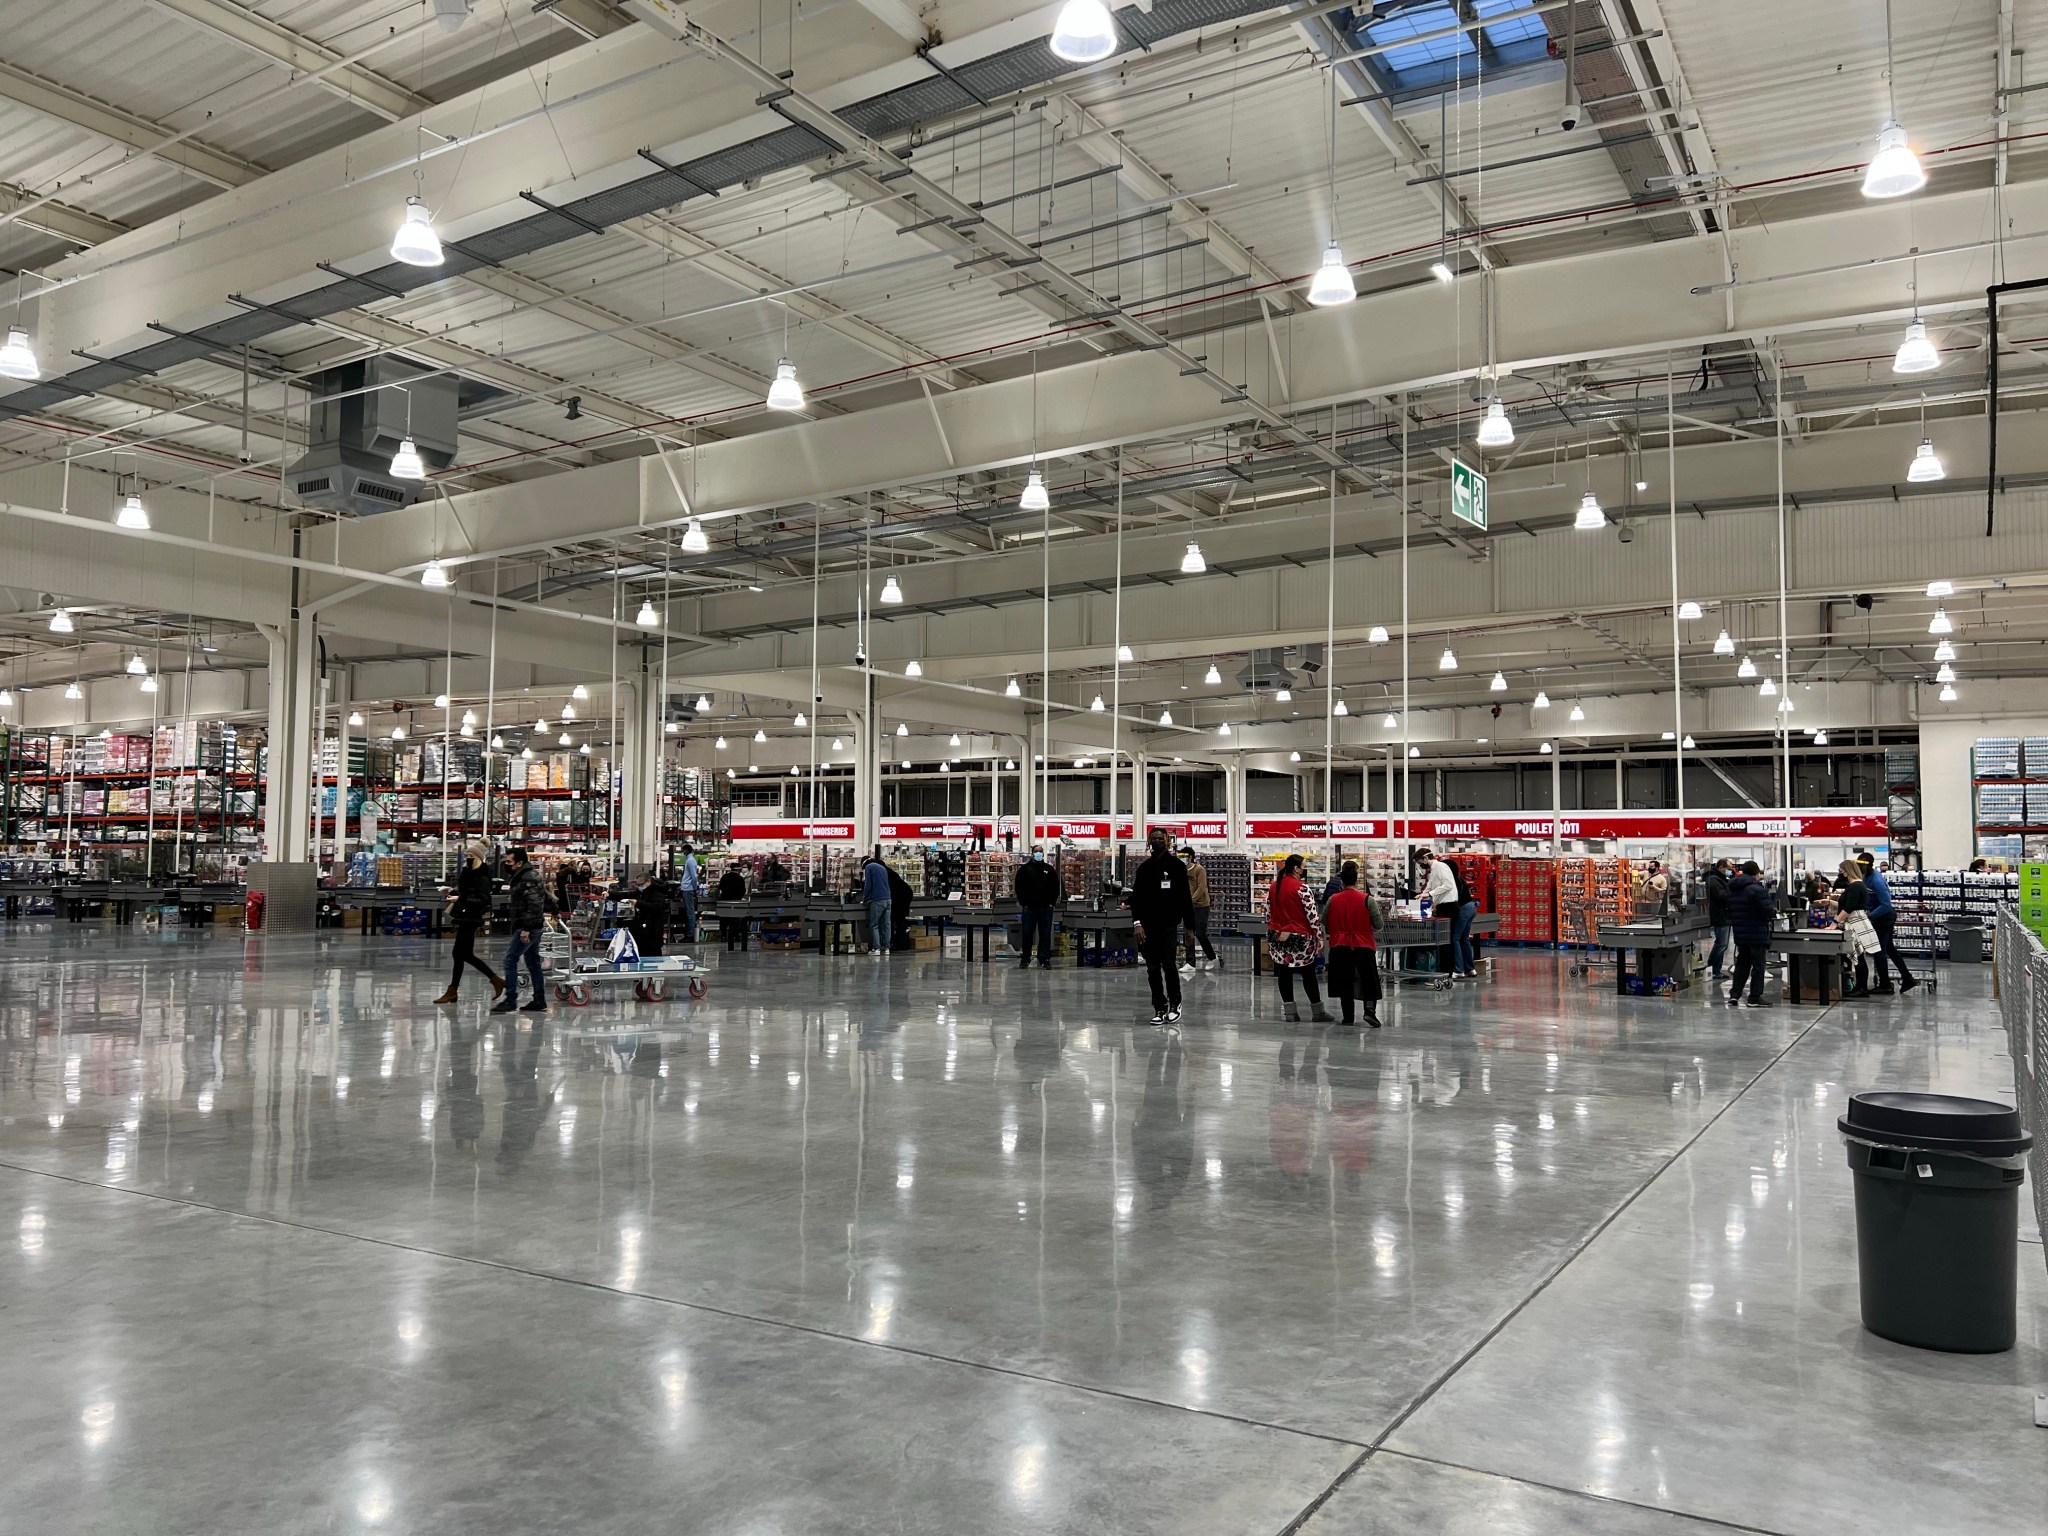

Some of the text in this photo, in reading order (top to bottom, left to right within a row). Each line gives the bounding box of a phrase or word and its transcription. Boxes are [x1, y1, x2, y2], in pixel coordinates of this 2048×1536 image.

[1191, 824, 1222, 835] VIANDE
[1337, 825, 1369, 833] VIANDE
[1434, 823, 1480, 835] VOLAILLE
[1514, 822, 1554, 834] POULET
[1706, 822, 1746, 830] KIRKLAND
